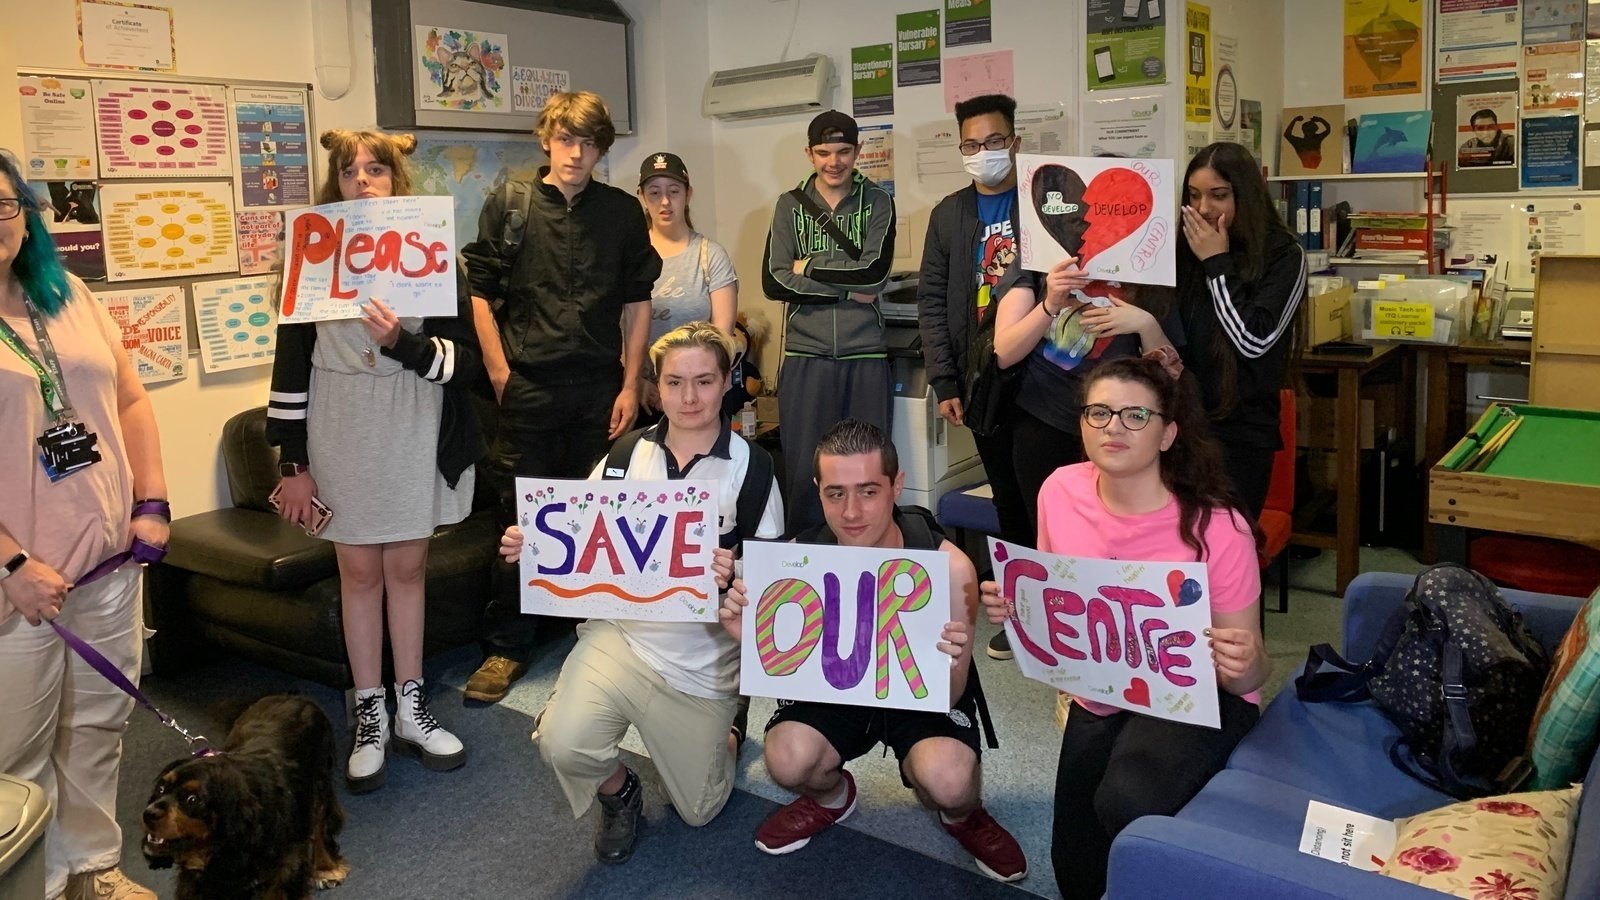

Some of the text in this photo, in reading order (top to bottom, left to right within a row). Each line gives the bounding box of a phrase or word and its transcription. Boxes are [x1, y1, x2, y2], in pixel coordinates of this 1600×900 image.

[111, 18, 142, 27] Certificate
[897, 26, 938, 41] Vulnerable
[898, 40, 927, 52] Bursary
[853, 59, 892, 72] Discretionary
[853, 70, 876, 80] Bursary
[1132, 161, 1159, 185] OUR
[1047, 193, 1062, 201] NO
[1042, 203, 1079, 214] DEVELOP
[1093, 202, 1148, 216] DEVELOP
[80, 242, 100, 252] you?
[1133, 221, 1166, 269] CENTRE
[146, 326, 182, 342] VOICE
[138, 345, 158, 361] MAGNA
[155, 354, 173, 370] CARTA
[535, 502, 705, 578] SAVE
[781, 559, 805, 568] Develop
[755, 558, 932, 700] OUR
[1342, 823, 1355, 838] here
[1341, 838, 1353, 848] sit
[1341, 847, 1351, 862] not
